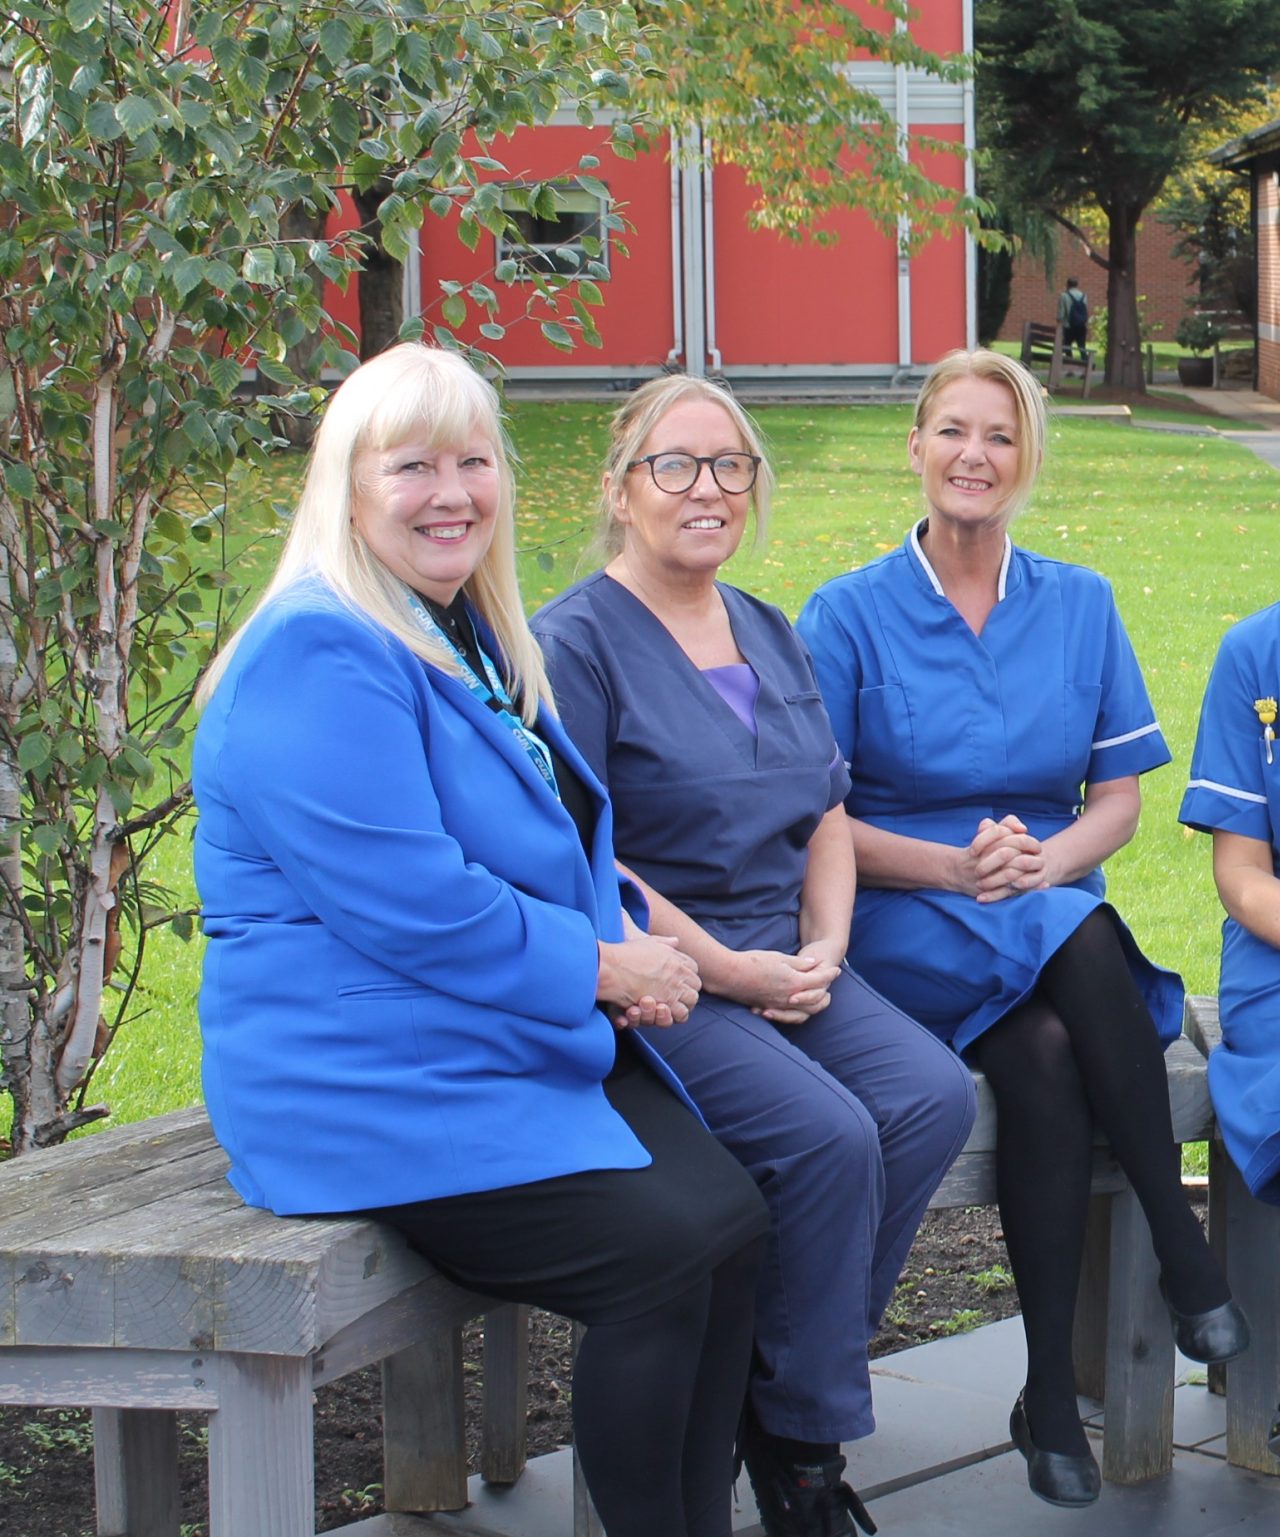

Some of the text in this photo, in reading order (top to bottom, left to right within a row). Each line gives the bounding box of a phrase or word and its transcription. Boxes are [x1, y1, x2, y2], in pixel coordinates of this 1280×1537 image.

[413, 607, 434, 631] NHS
[460, 665, 480, 689] NHS
[485, 665, 501, 690] NHS
[513, 728, 532, 751] NHS
